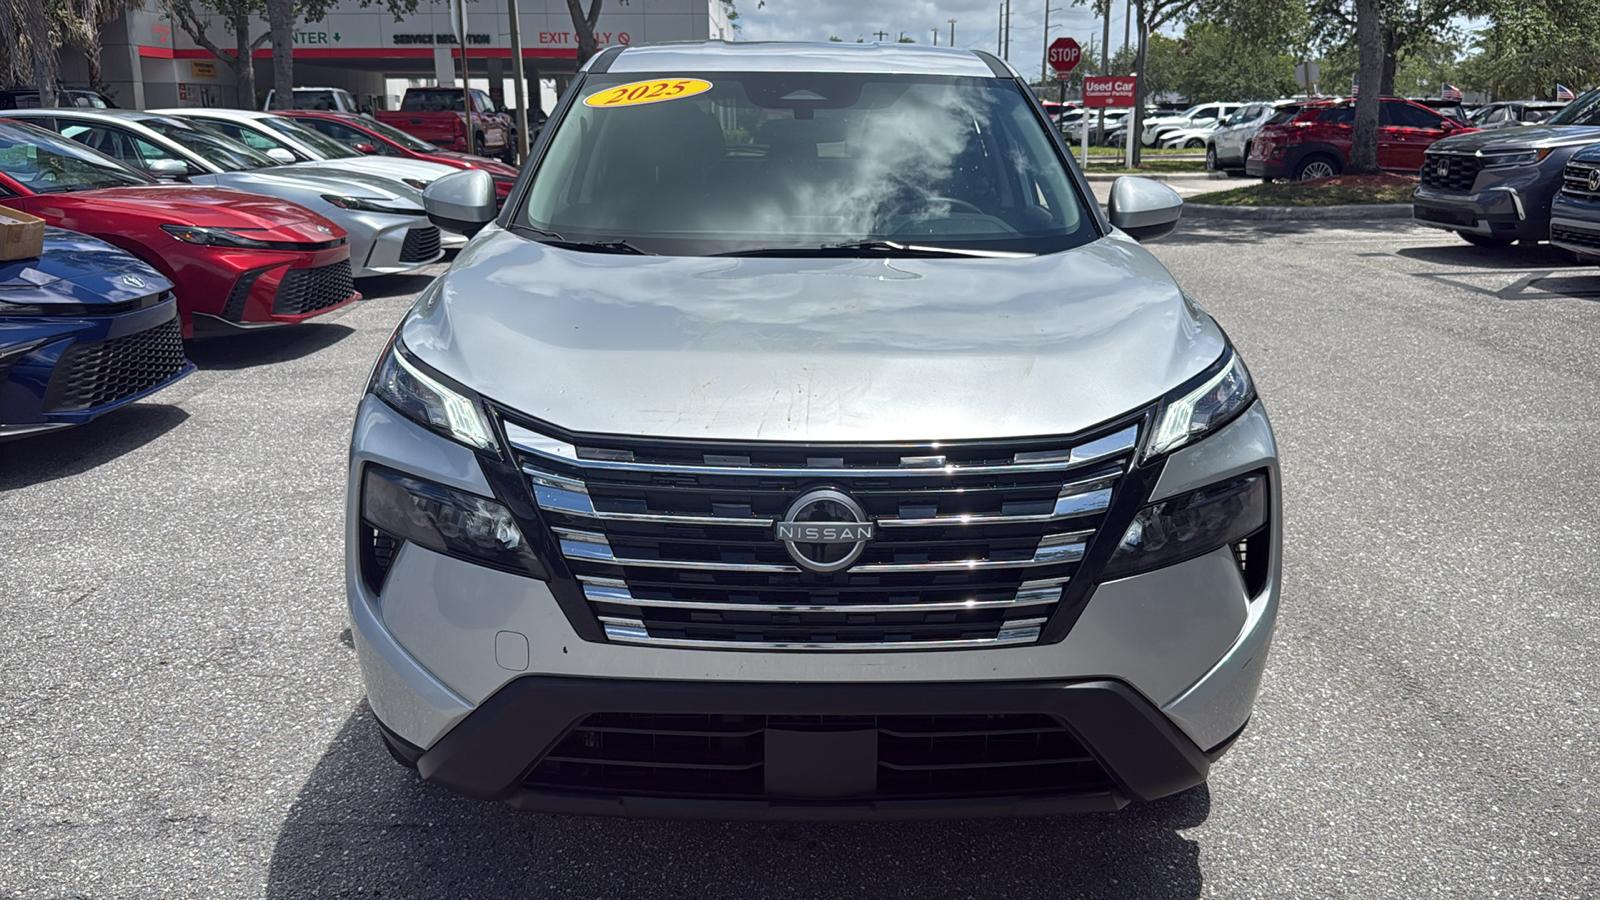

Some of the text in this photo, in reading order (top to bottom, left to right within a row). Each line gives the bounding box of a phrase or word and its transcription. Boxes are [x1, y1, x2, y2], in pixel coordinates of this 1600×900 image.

[288, 32, 328, 44] NTER
[393, 34, 490, 44] SERVICE RECTION
[539, 32, 612, 44] EXIT OLY
[1050, 48, 1079, 62] STOP
[604, 81, 691, 104] 2025
[1086, 82, 1134, 91] Used Car
[779, 526, 871, 539] NISSAN
